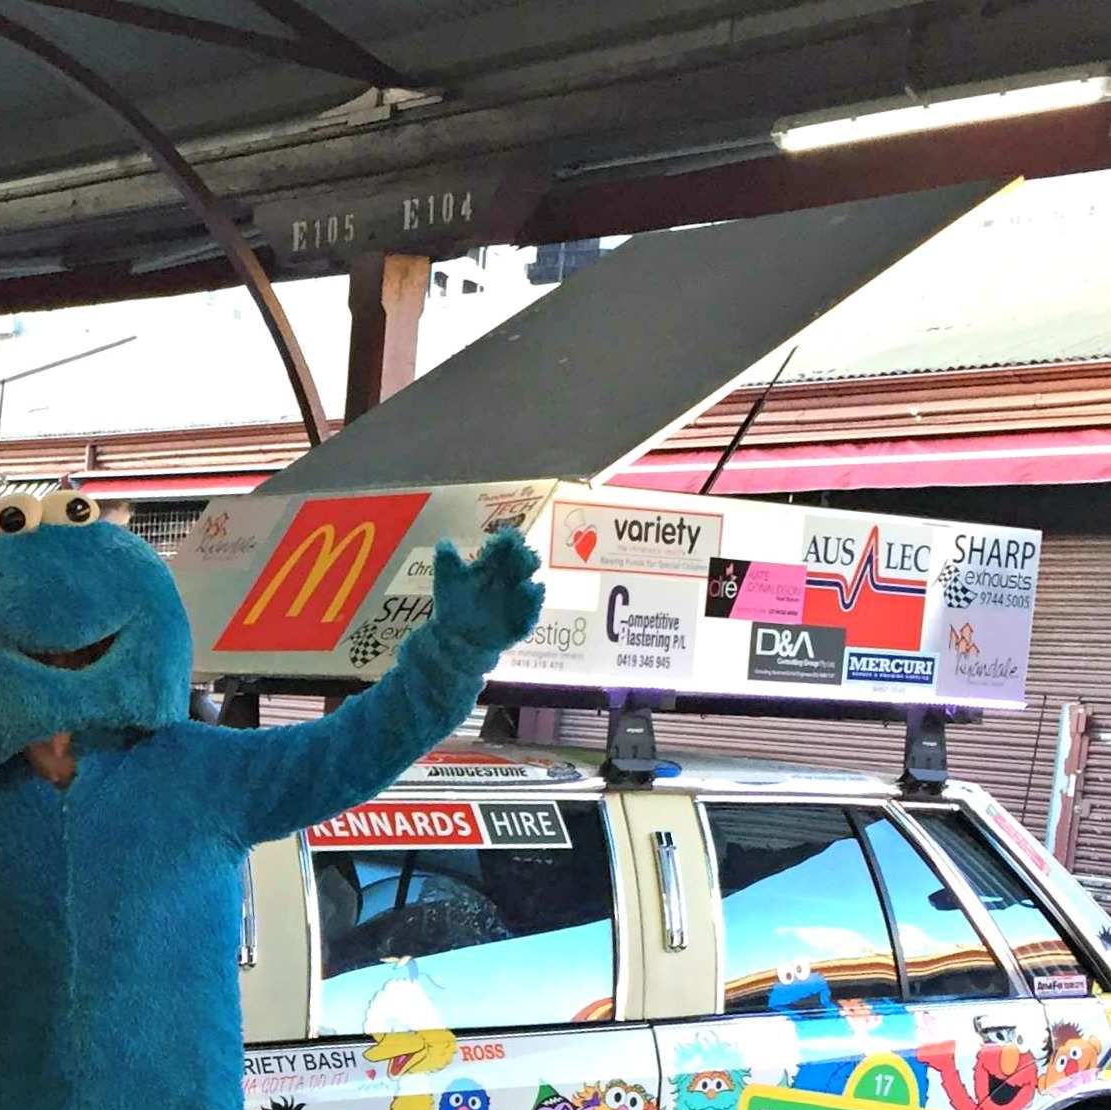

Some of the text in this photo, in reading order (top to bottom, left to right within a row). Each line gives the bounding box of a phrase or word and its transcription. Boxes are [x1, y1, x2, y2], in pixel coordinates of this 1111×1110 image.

[403, 192, 472, 230] E104
[292, 214, 355, 252] E105
[614, 516, 701, 554] variety
[953, 534, 1036, 570] SHARP
[965, 570, 1032, 591] exhausts
[756, 627, 815, 658] D&A
[849, 656, 933, 676] MERCURI
[427, 764, 529, 778] BRIDGESTONE
[490, 810, 557, 837] HIRE
[304, 1050, 357, 1071] BASH
[460, 1043, 506, 1062] ROSS
[873, 1072, 895, 1097] 17
